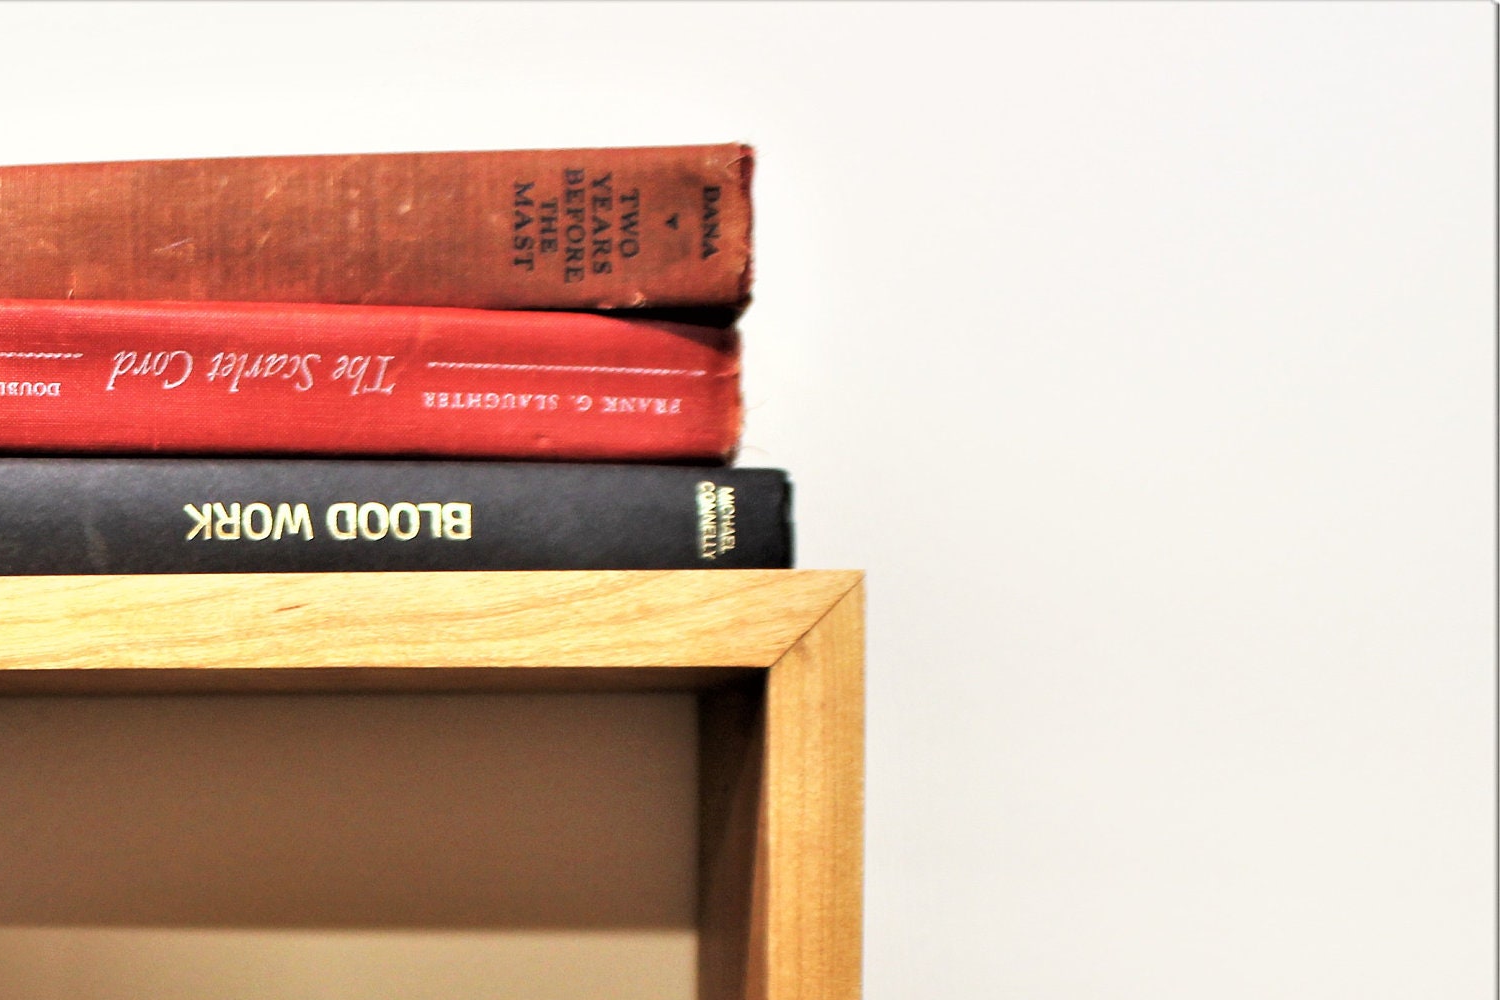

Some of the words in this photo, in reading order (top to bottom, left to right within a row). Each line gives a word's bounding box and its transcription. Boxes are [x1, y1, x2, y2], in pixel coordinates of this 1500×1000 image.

[513, 181, 534, 271] MAST
[539, 197, 557, 254] THE
[564, 168, 585, 284] BEFORE
[592, 172, 613, 274] YEARS
[619, 188, 639, 258] TWO
[702, 186, 720, 259] DANA
[106, 349, 193, 391] Cord
[207, 351, 320, 393] Scarlet
[333, 354, 395, 395] The
[423, 391, 559, 410] SLAUGHTER
[571, 395, 593, 411] G.
[604, 397, 682, 415] FRANK
[183, 502, 314, 541] WORK
[326, 502, 472, 541] BLOOD
[697, 481, 716, 559] CONNELLY
[718, 486, 735, 554] MICHAEL
